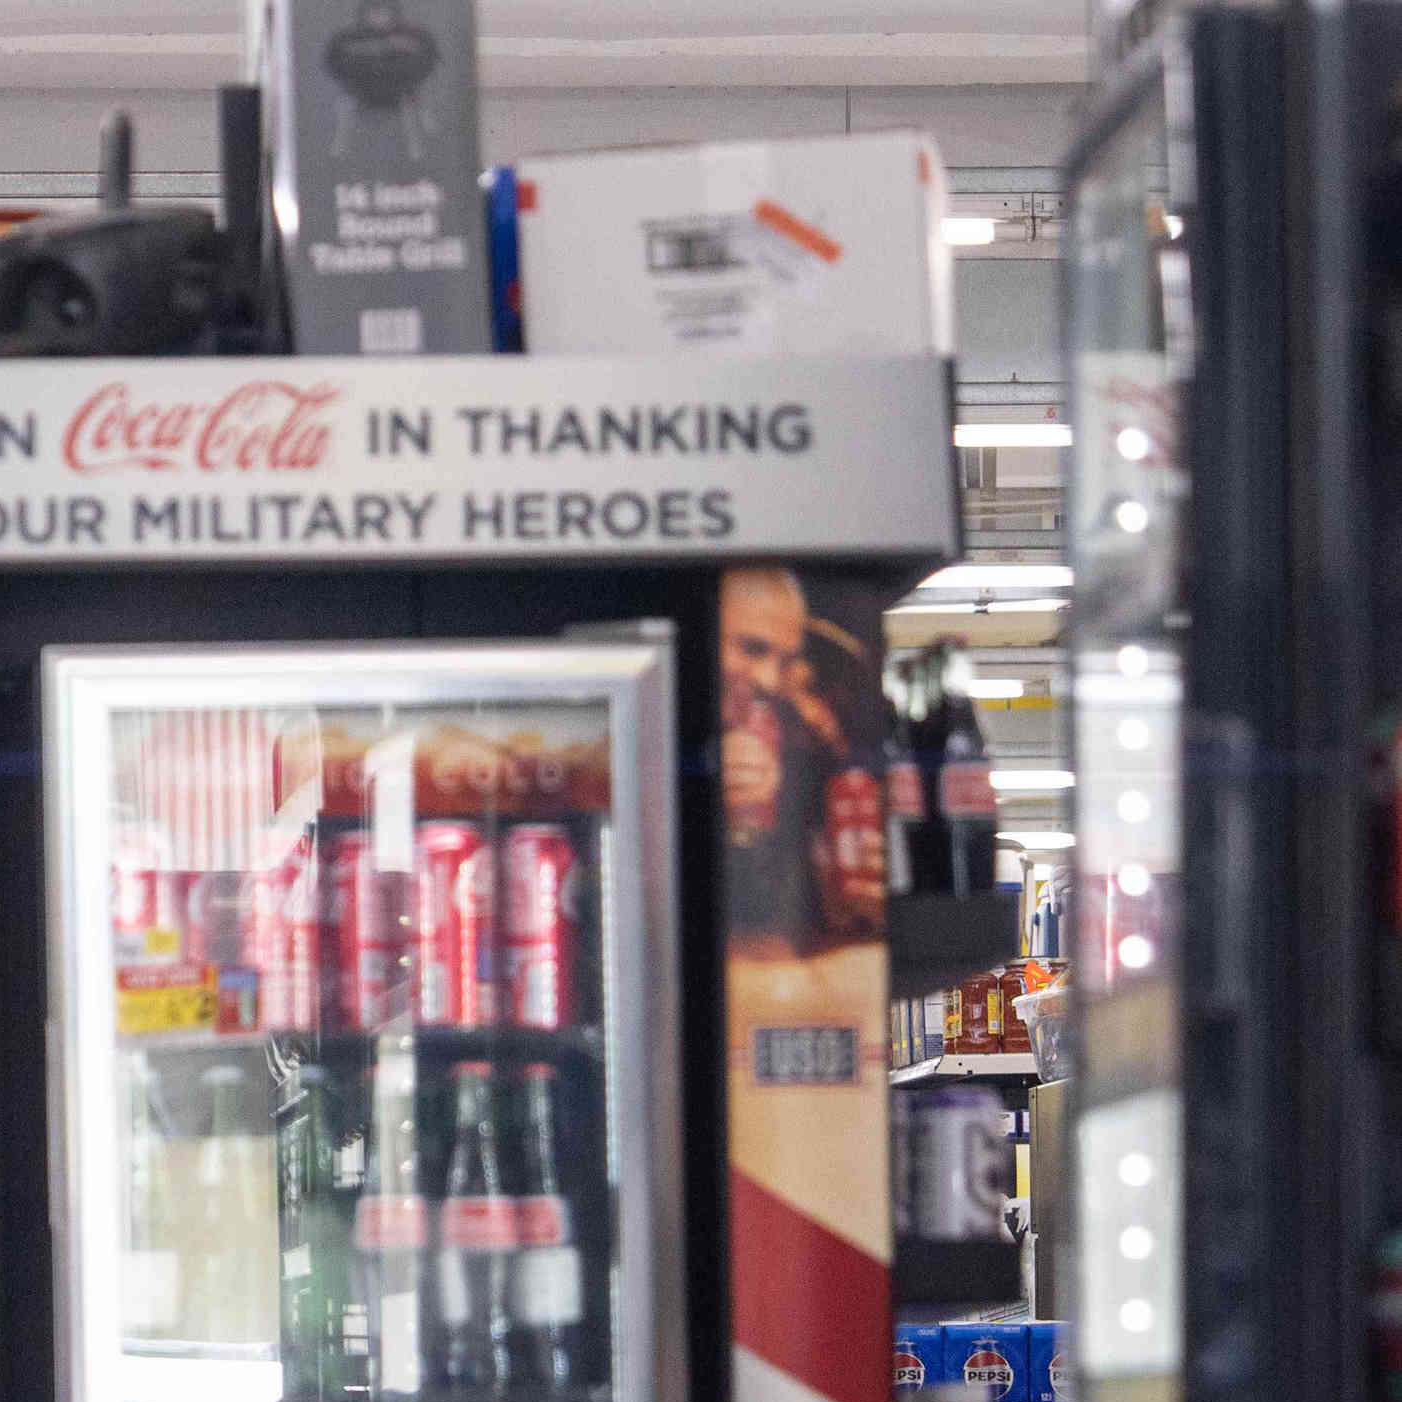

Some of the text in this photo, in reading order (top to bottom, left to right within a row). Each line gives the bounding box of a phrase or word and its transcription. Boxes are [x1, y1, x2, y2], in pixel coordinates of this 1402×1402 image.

[369, 409, 433, 454] IN
[458, 405, 816, 455] THANKING
[133, 495, 437, 543] MILITARY
[465, 490, 737, 540] HEROES
[894, 1369, 922, 1382] PSI
[967, 1369, 1011, 1382] PEPSI
